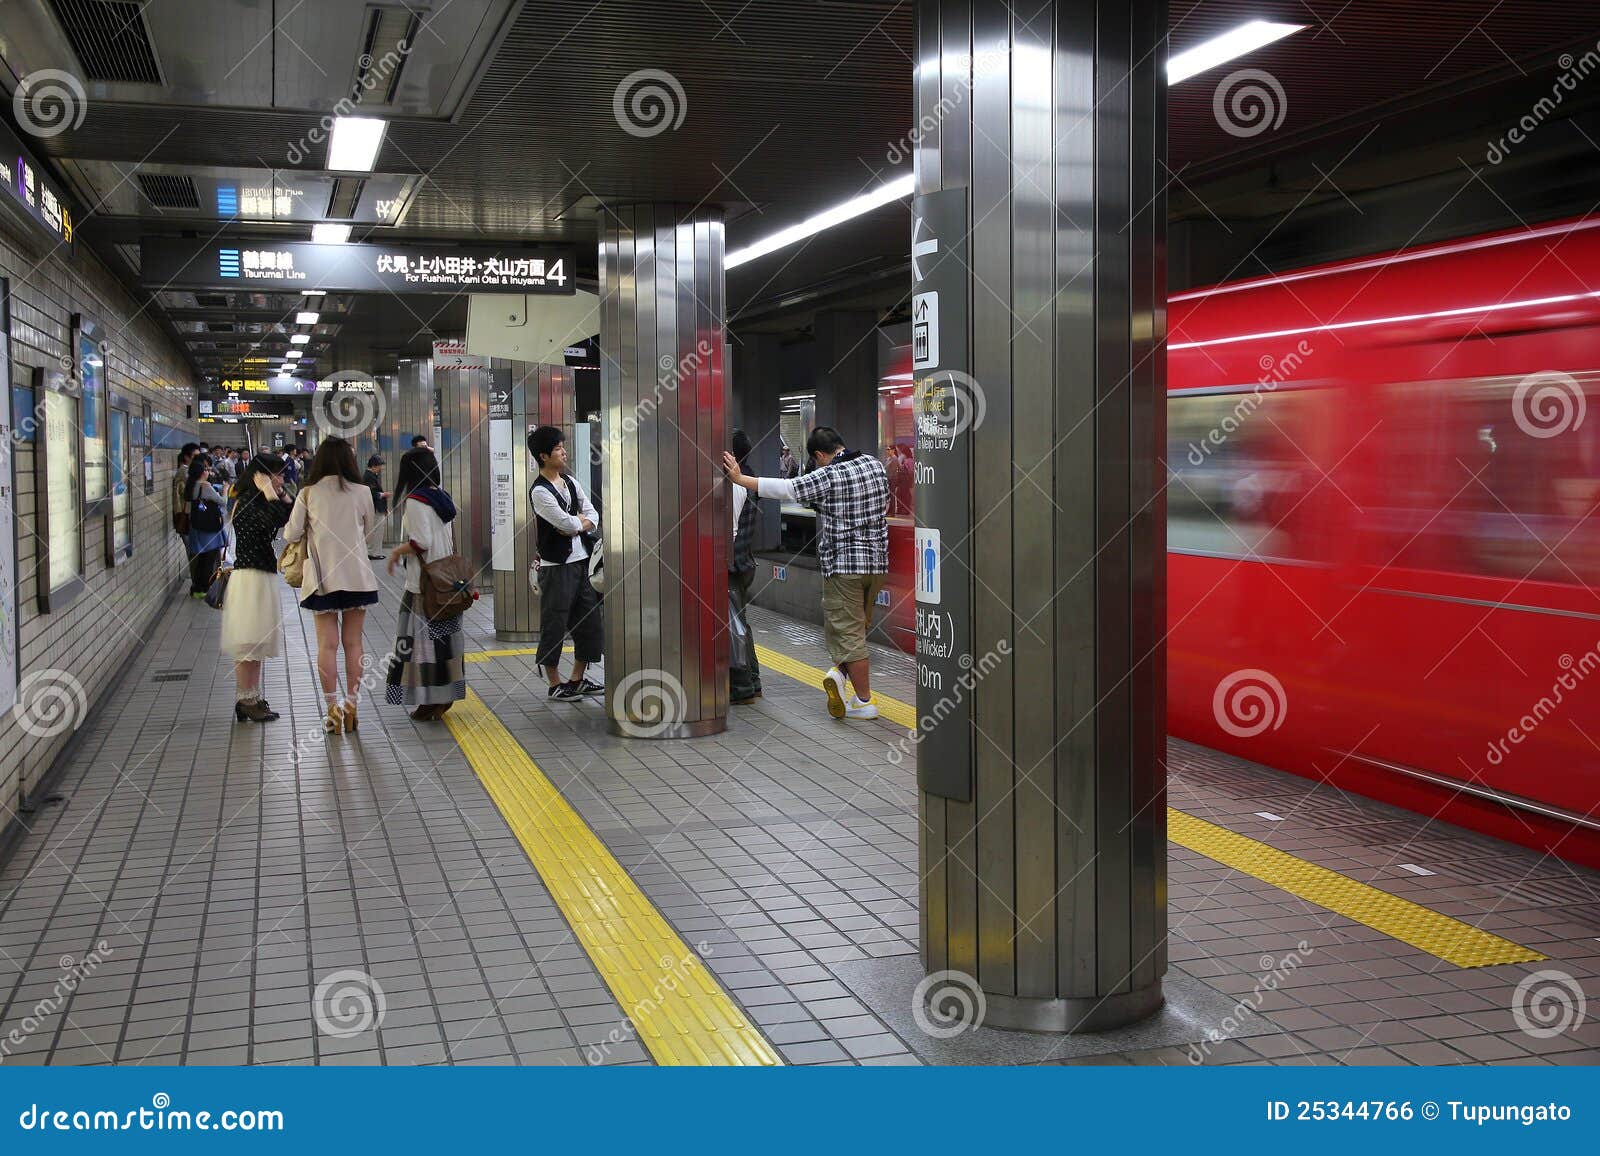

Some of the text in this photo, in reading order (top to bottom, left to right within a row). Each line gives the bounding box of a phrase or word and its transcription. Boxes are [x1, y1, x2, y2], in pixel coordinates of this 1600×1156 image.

[286, 271, 306, 280] Line
[376, 255, 567, 287] 伏見・上小田井・犬山方面 4
[405, 273, 420, 283] For
[421, 273, 457, 285] Fushimi,
[458, 274, 480, 284] Kami
[501, 276, 508, 285] &
[510, 275, 546, 287] Inuyama
